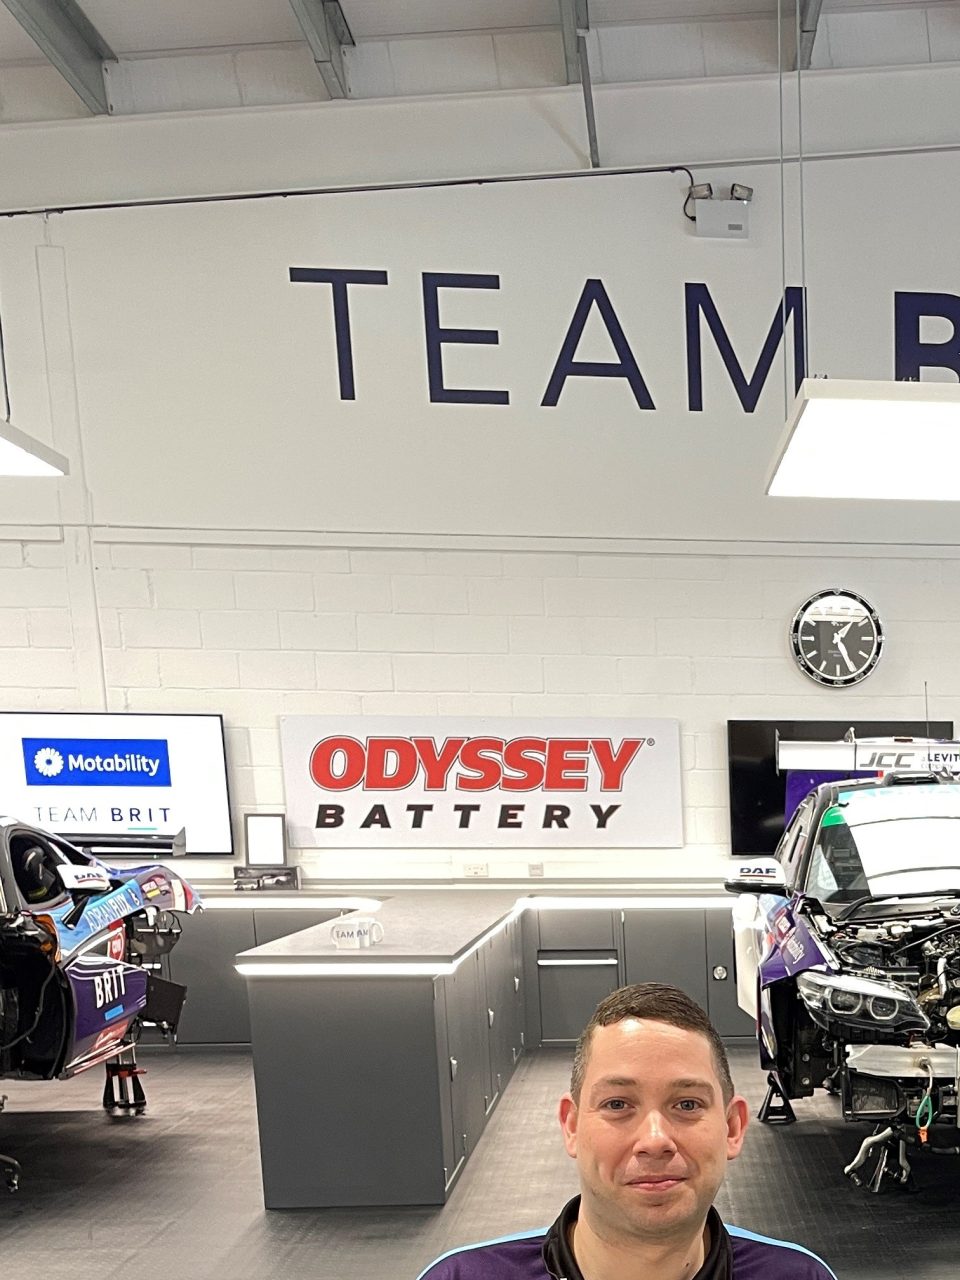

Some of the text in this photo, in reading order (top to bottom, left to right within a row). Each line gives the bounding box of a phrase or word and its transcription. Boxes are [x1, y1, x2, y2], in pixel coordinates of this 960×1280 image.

[289, 267, 807, 413] TEAM
[68, 753, 160, 776] Motability
[860, 752, 915, 768] JCC
[33, 806, 171, 823] TEAM BRIT
[315, 804, 621, 829] BATTERY
[740, 867, 777, 875] DAF
[94, 965, 125, 1009] BRIT
